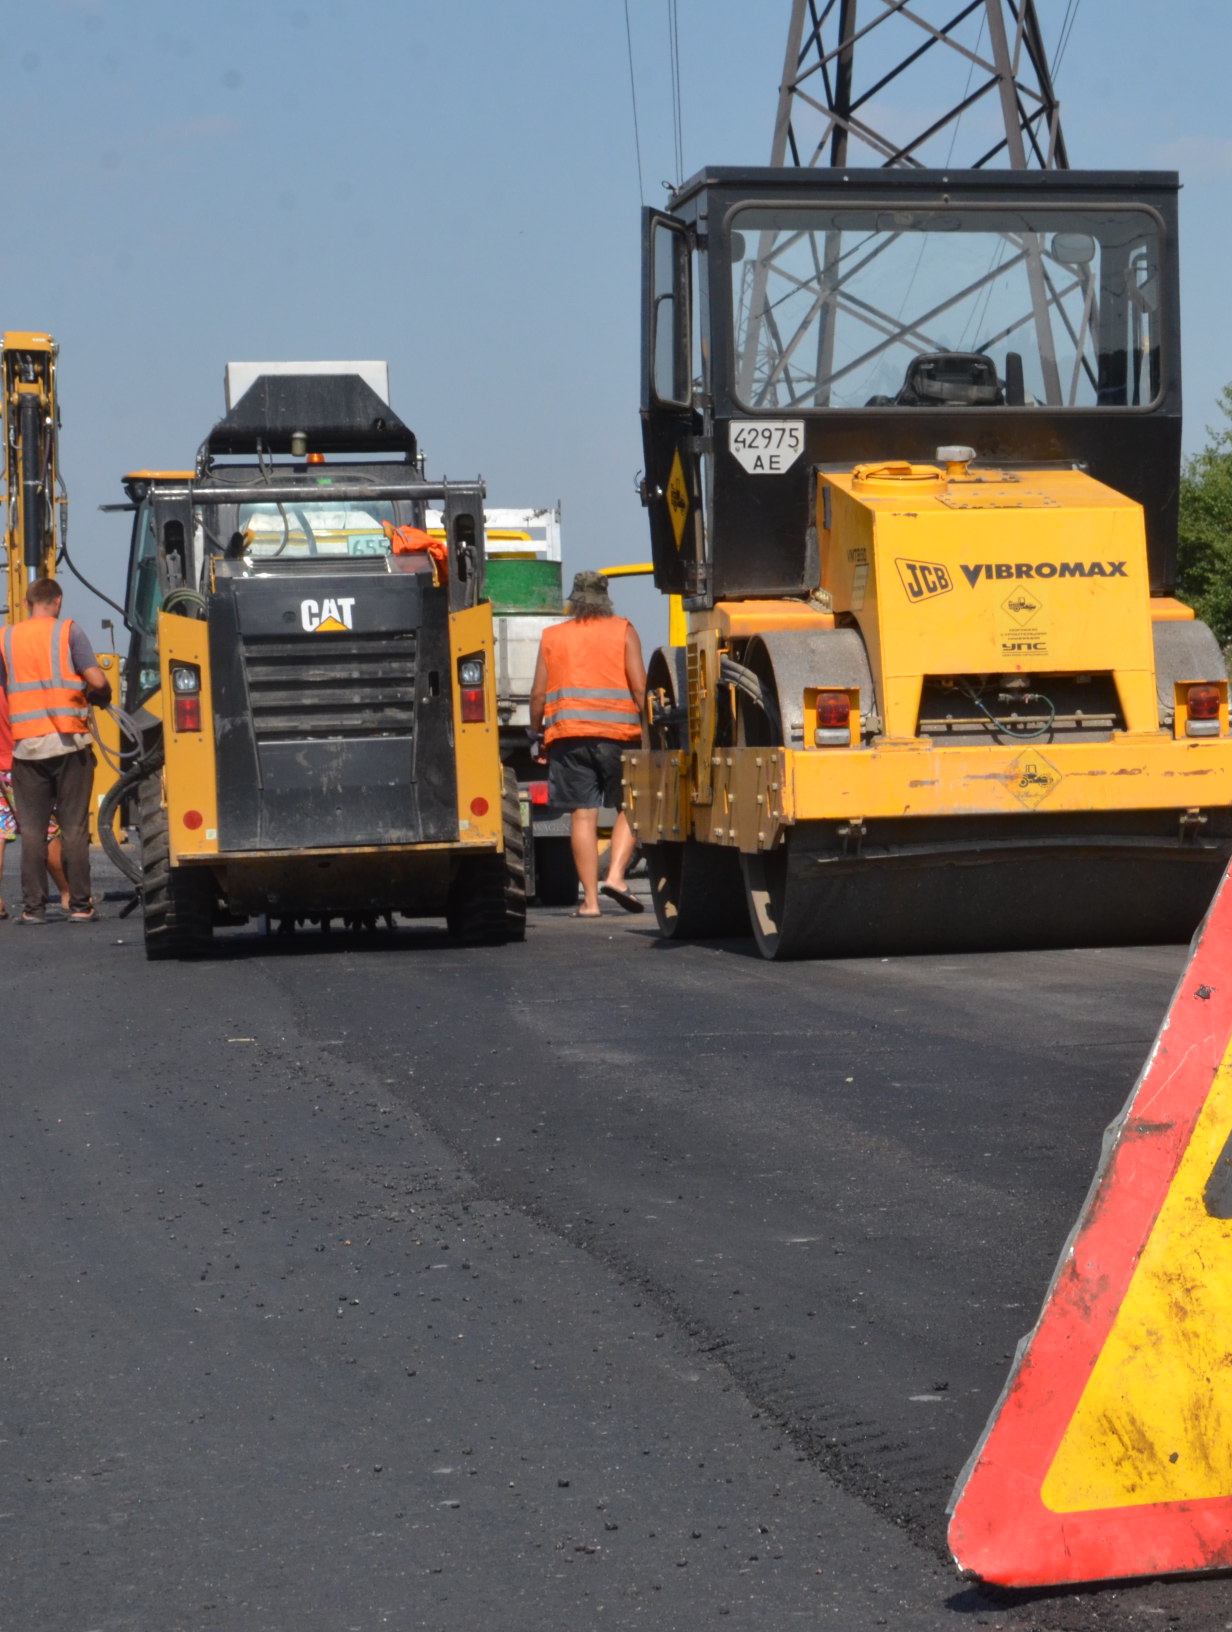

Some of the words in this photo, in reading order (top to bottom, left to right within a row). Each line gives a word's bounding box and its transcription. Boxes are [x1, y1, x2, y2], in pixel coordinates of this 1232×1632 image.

[734, 428, 799, 448] 42975
[753, 455, 781, 470] AE
[905, 563, 949, 598] JCB
[960, 561, 1128, 589] VIBROMAX
[301, 597, 355, 632] CAT
